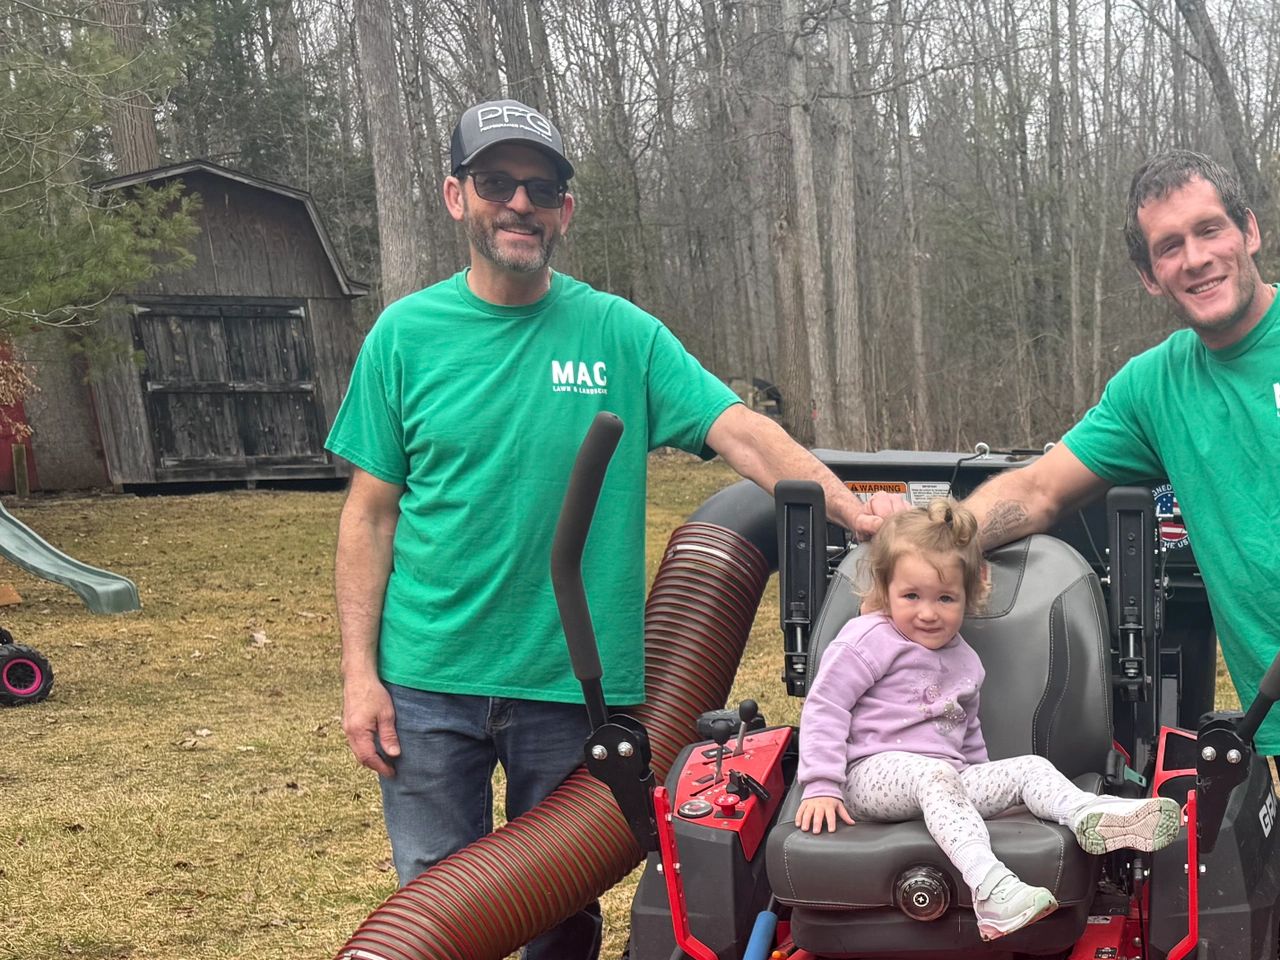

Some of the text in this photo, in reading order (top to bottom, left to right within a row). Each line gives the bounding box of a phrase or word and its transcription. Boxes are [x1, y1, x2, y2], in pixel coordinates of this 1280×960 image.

[478, 106, 552, 137] PFG
[551, 360, 607, 387] MAC
[860, 484, 901, 493] WARNING
